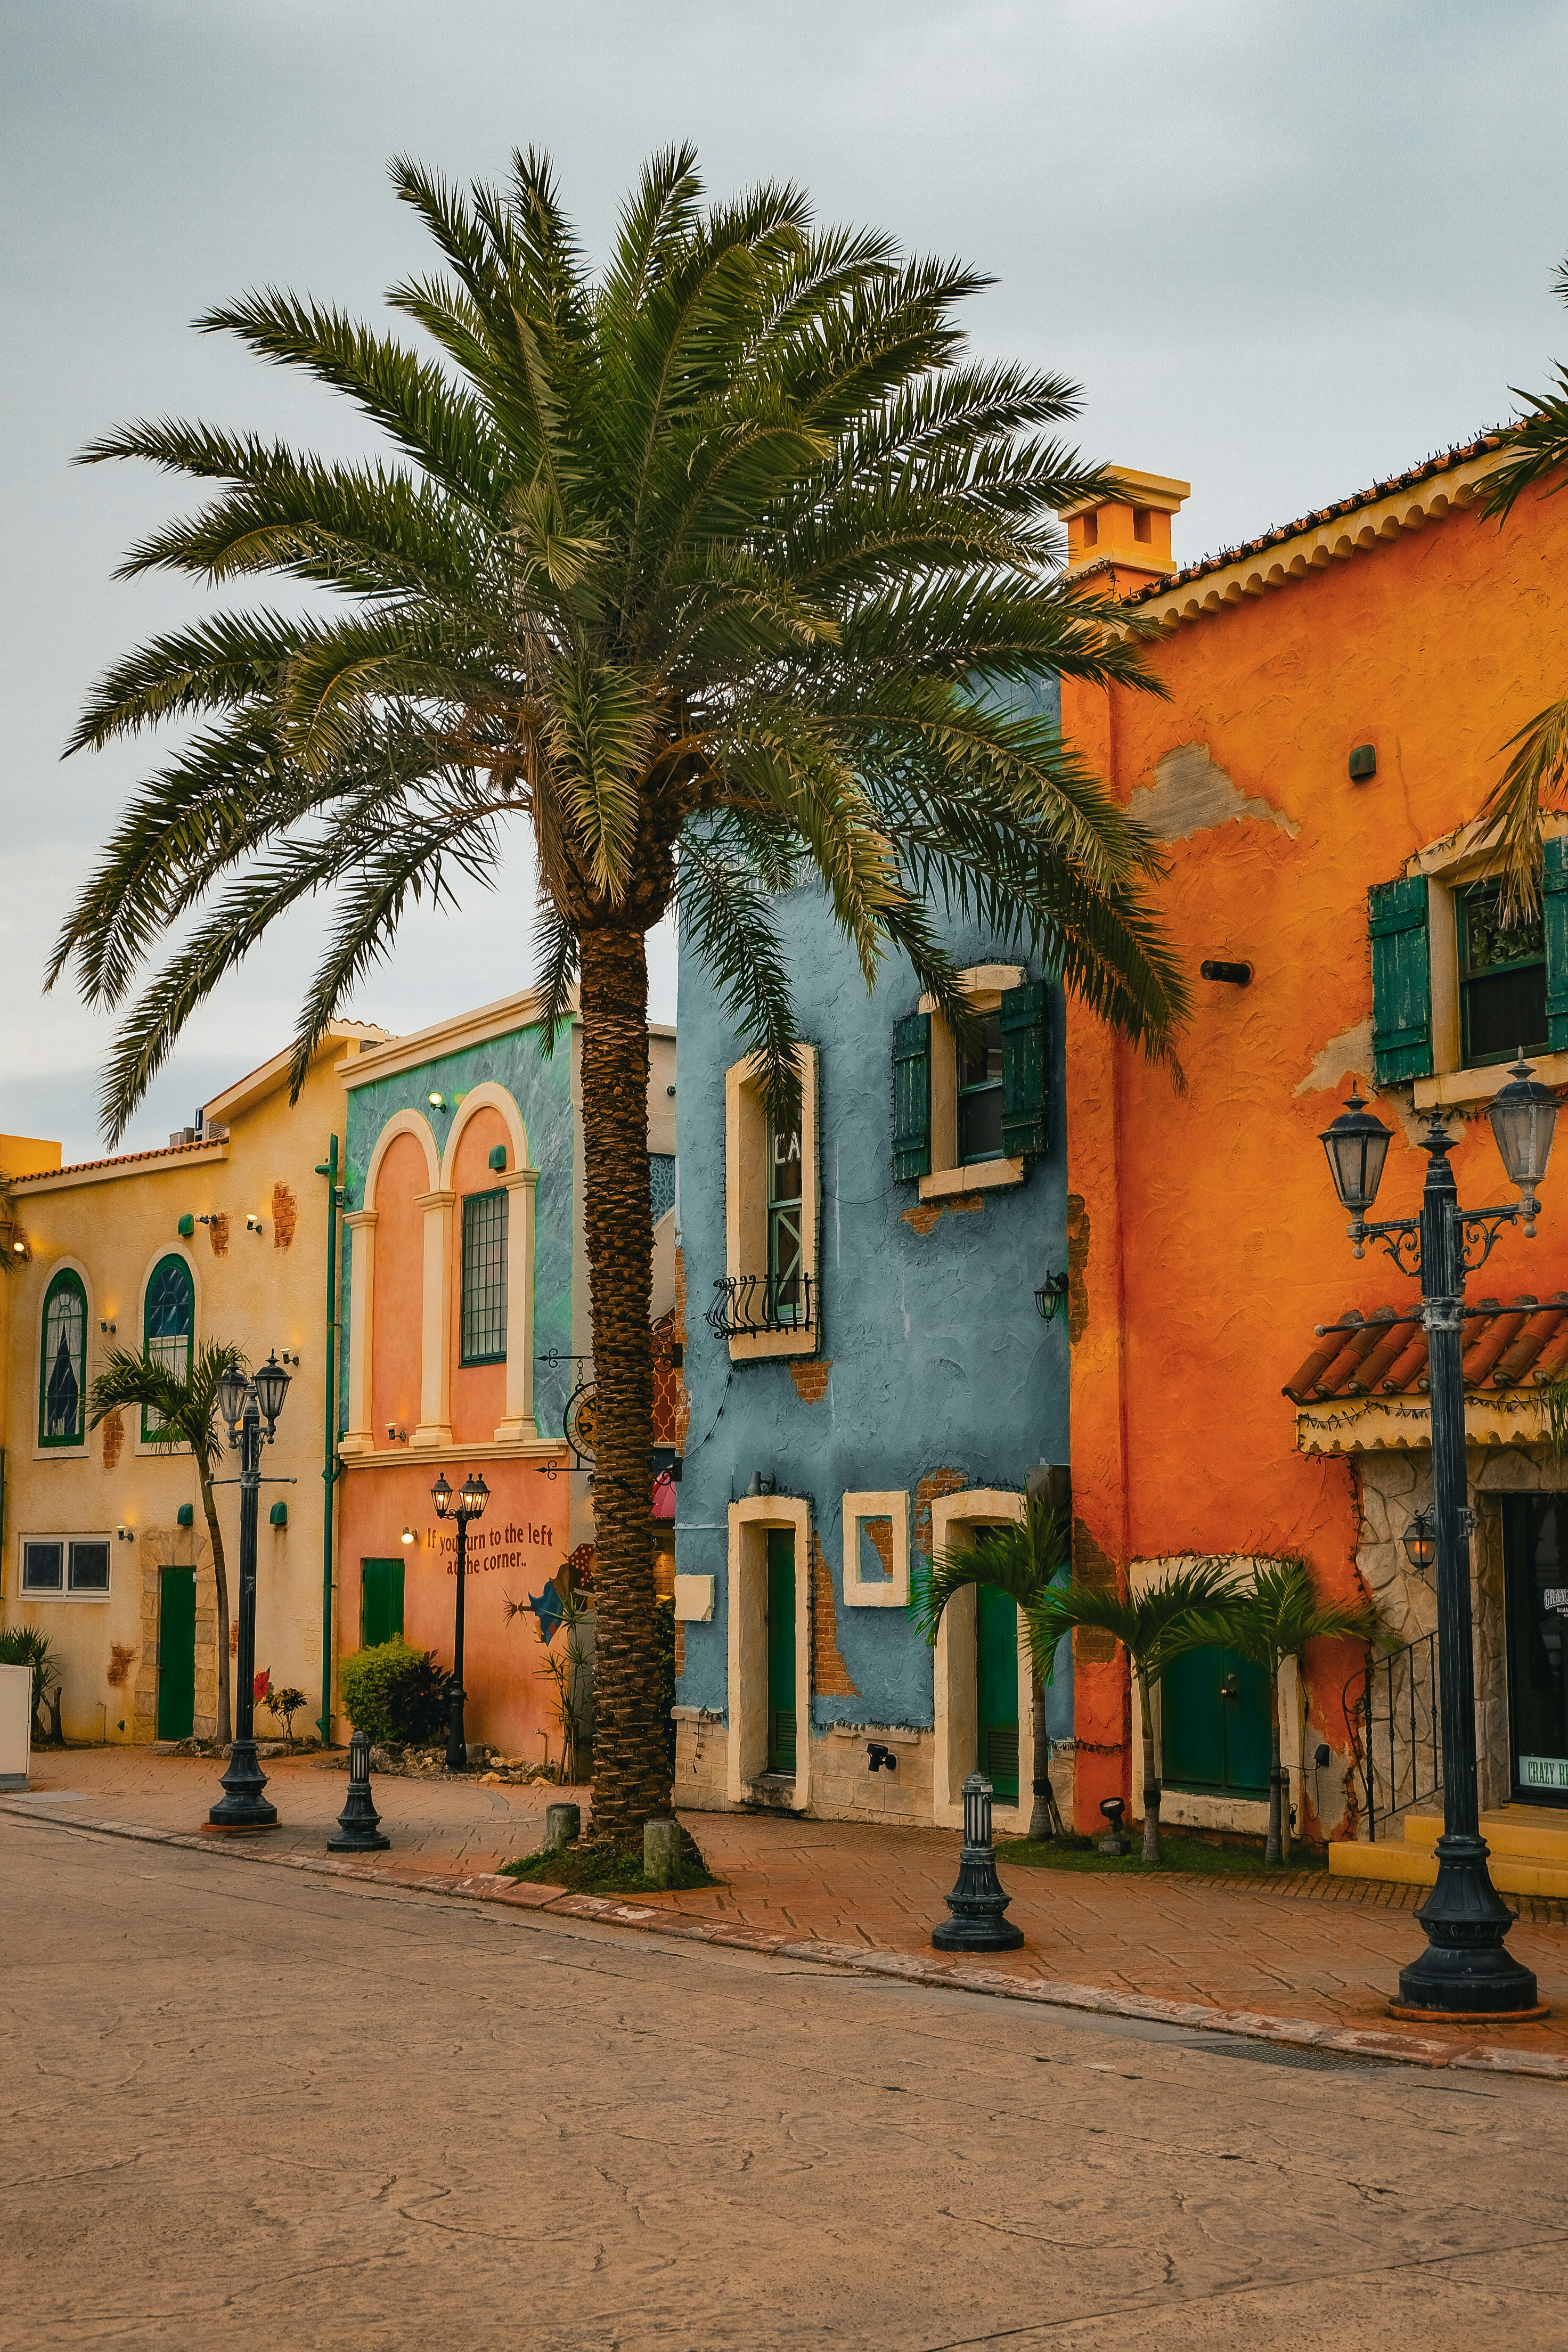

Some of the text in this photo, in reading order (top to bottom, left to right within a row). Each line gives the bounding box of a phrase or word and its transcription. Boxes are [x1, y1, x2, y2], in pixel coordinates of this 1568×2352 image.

[428, 1528, 437, 1549] If
[465, 1533, 486, 1551] urn
[489, 1528, 501, 1546] to
[505, 1522, 524, 1544] the
[528, 1522, 553, 1547] left
[464, 1555, 480, 1575] he
[1528, 1761, 1555, 1785] CRAZY
